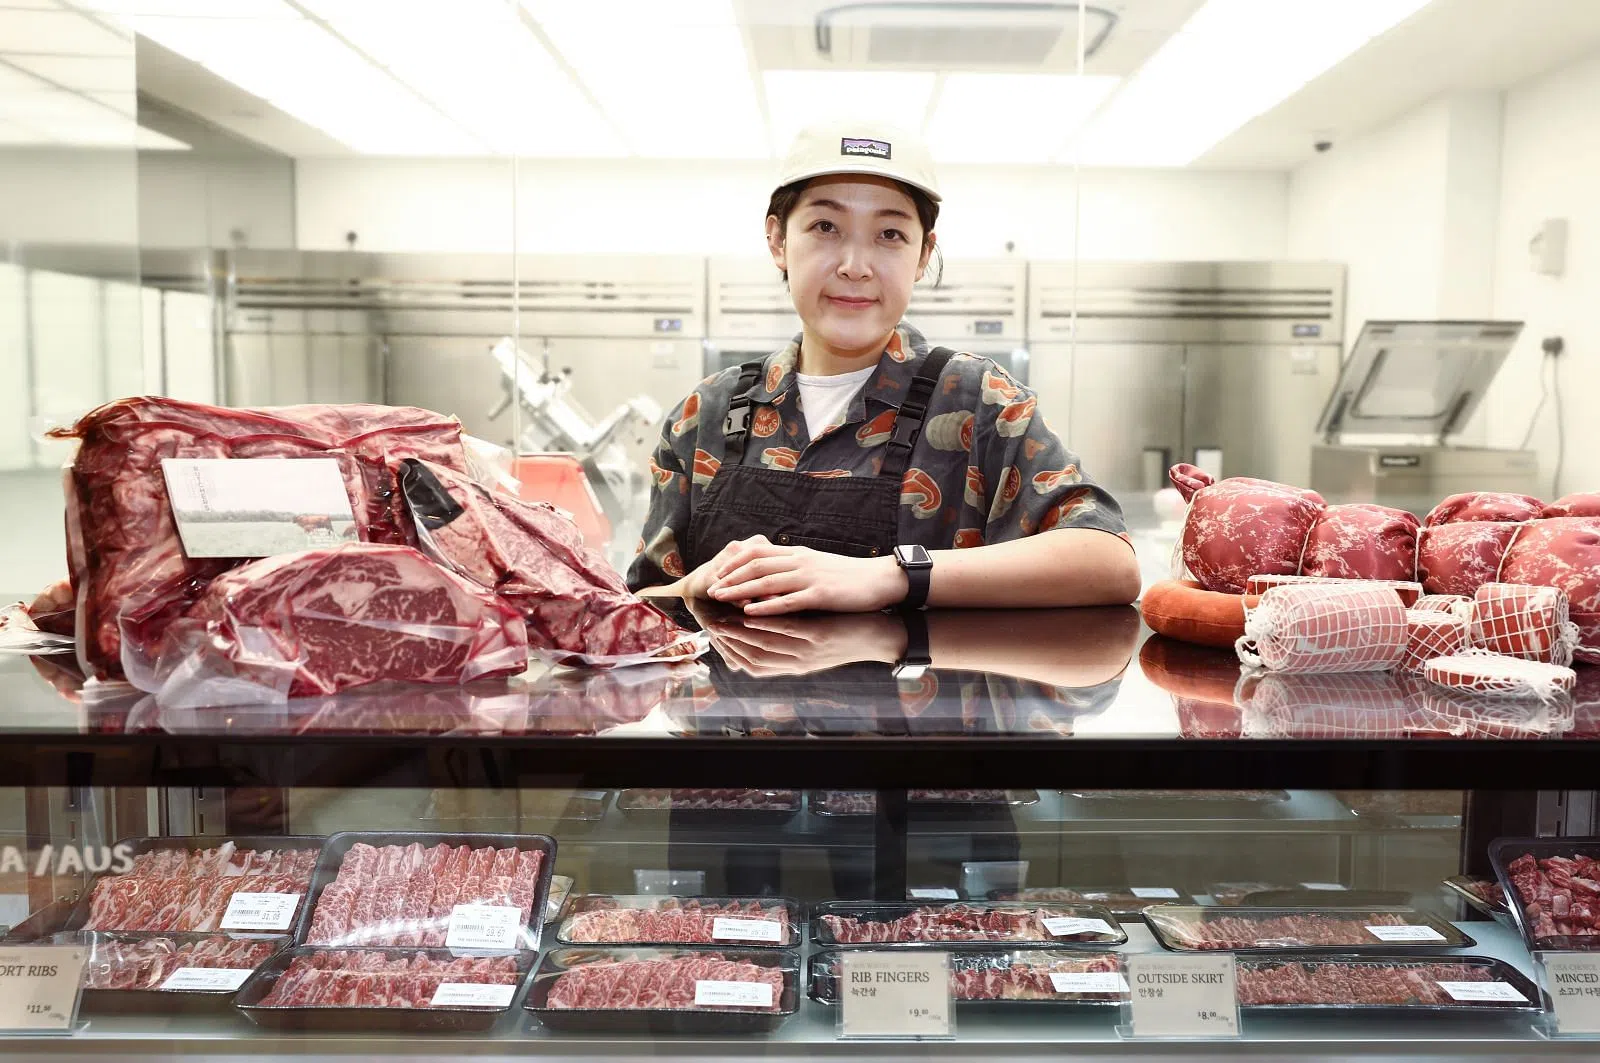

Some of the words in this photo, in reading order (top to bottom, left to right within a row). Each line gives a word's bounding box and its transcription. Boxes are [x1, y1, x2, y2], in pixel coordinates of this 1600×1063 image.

[754, 418, 778, 434] DUDES
[28, 965, 58, 977] RIBS
[851, 971, 872, 983] RIB
[876, 971, 930, 983] FINGERS
[1137, 973, 1188, 984] OUTSIDE
[1191, 973, 1224, 984] SKIRT
[1555, 973, 1599, 983] MINCED
[1559, 987, 1583, 996] 소고기
